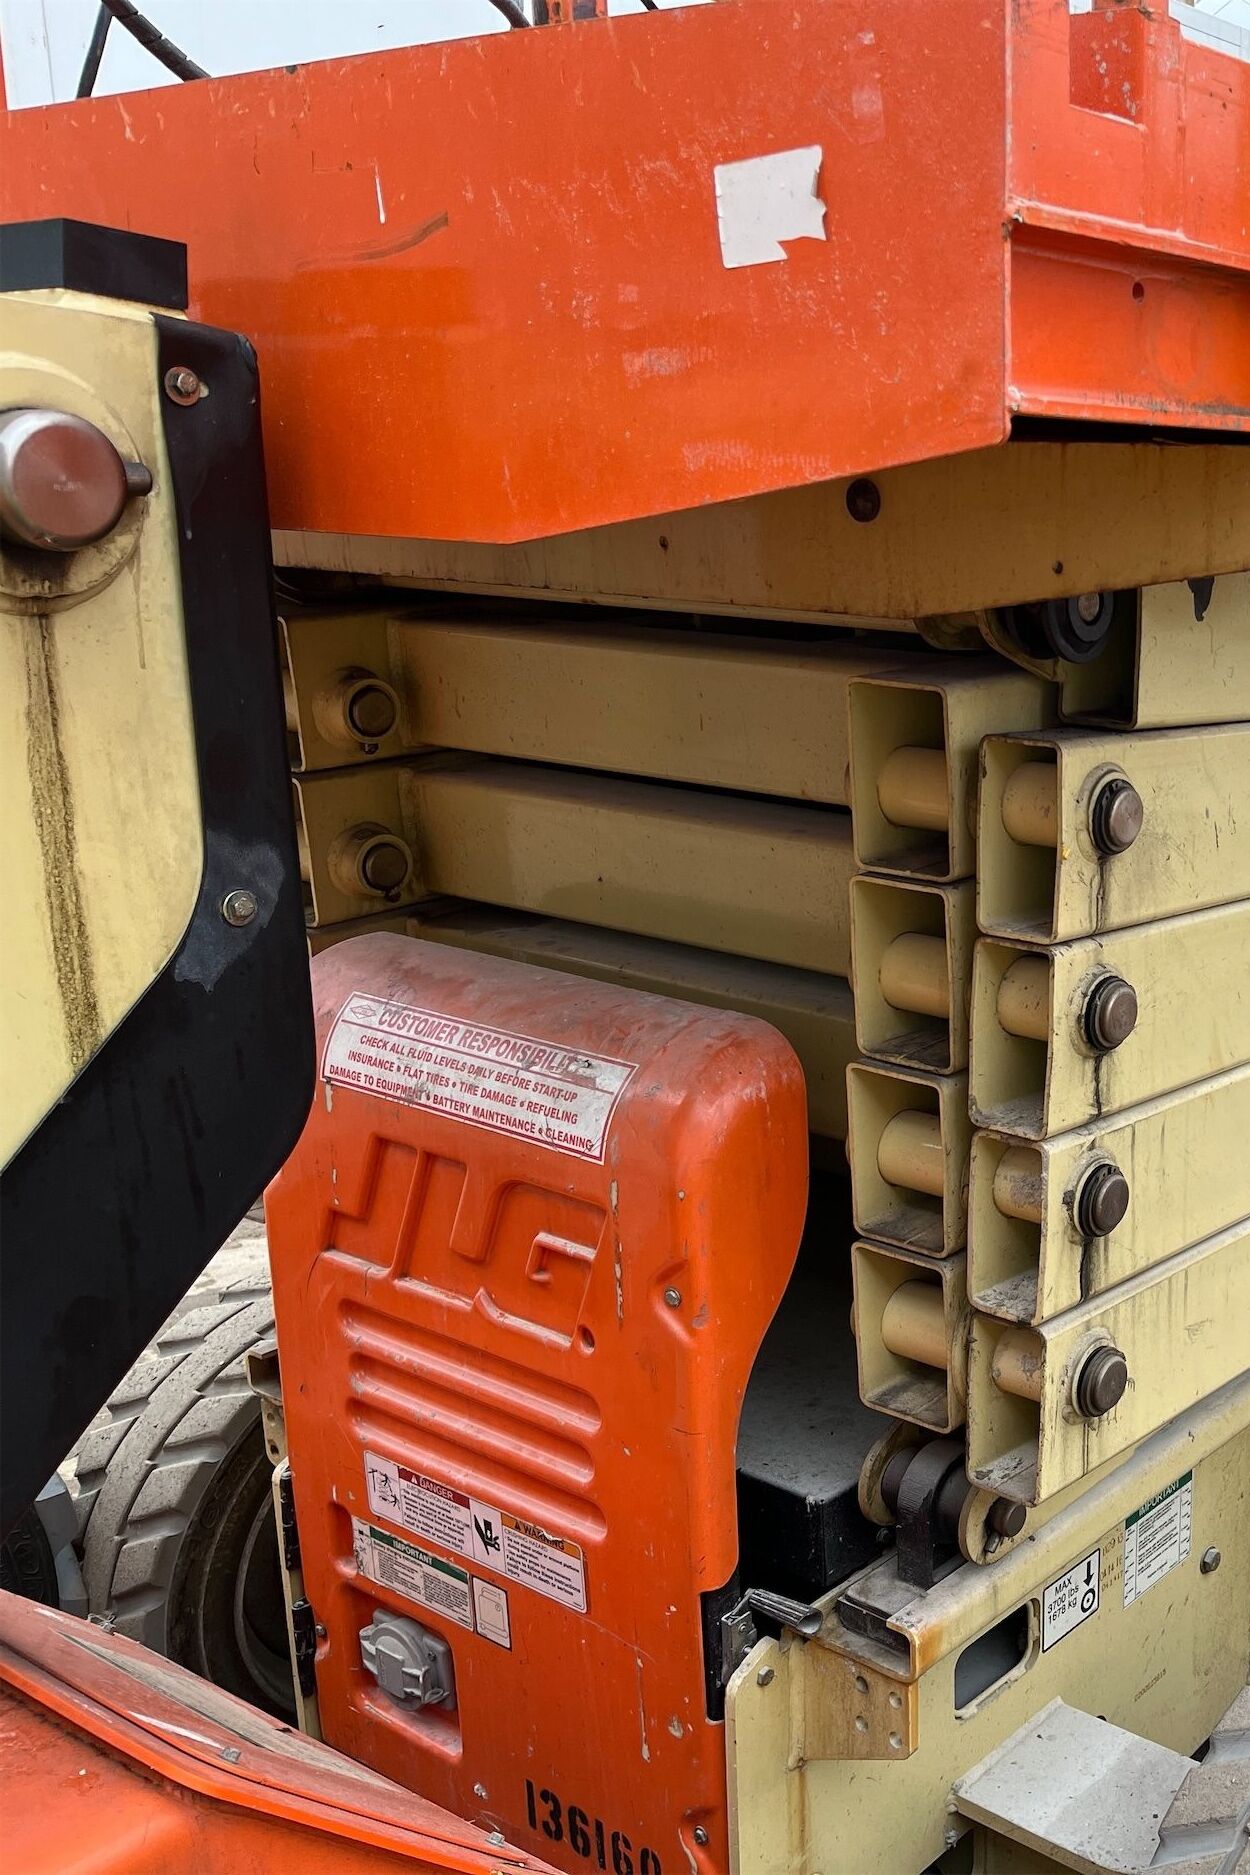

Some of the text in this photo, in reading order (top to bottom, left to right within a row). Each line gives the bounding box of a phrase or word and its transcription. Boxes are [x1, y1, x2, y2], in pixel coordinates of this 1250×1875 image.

[378, 1007, 460, 1044] CUSTOMER
[348, 1049, 578, 1125] INSURANCE FLAT TIRES TIRE DAMAGE REFUELING
[360, 1034, 578, 1103] CHECK ALL FLUID LEVELS DAILY BEFORE START-UP
[329, 1064, 362, 1082] DAMAGE
[363, 1073, 375, 1086] TO
[433, 1094, 471, 1114] BATTERY
[472, 1106, 536, 1134] MAINTENANCE
[546, 1127, 594, 1152] CLEANING
[319, 1131, 608, 1350] JLG
[419, 1477, 453, 1501] DANGER
[1138, 1479, 1178, 1517] IMPORTANT
[392, 1539, 432, 1565] IMPORTANT
[1047, 1585, 1079, 1614] 3700 lbs
[1055, 1575, 1073, 1597] MAX
[1048, 1597, 1077, 1624] 1678 kg
[524, 1778, 662, 1875] 136160
